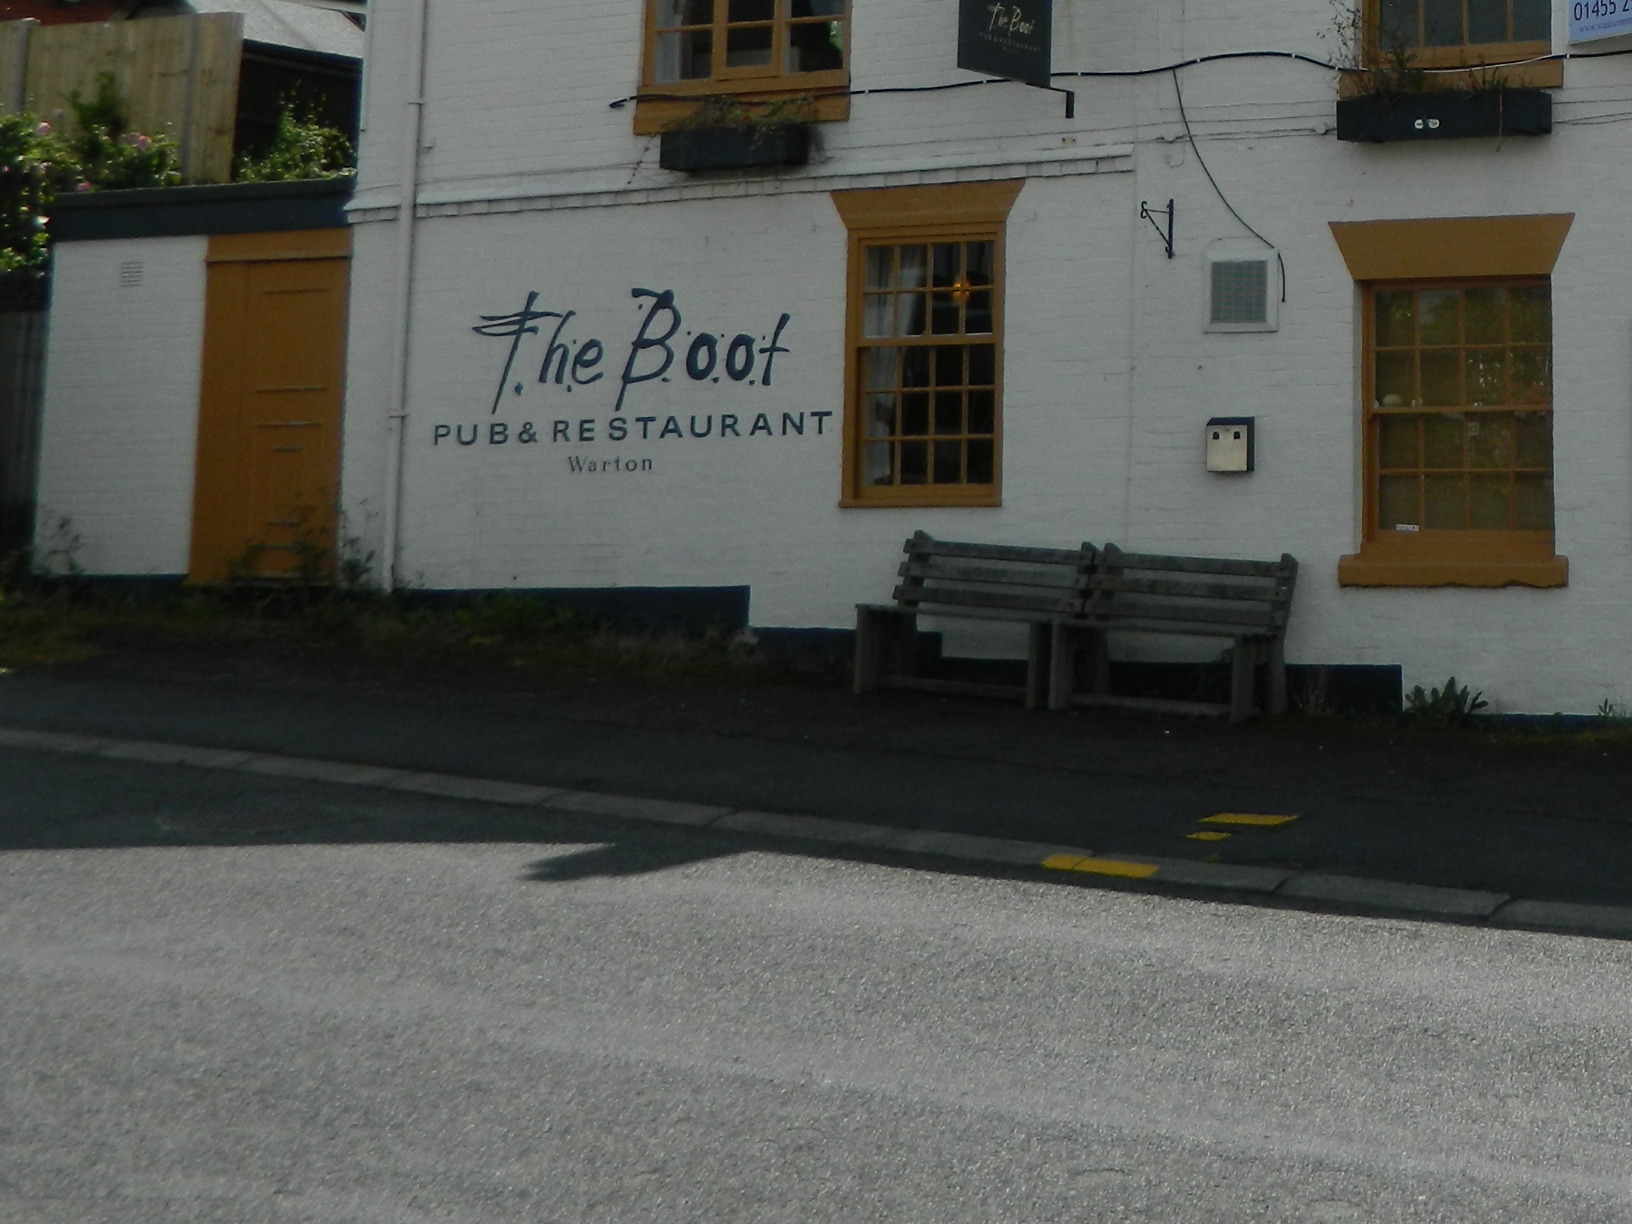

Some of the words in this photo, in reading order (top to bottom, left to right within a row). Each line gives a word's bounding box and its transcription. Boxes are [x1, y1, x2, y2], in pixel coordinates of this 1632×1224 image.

[471, 290, 605, 415] The
[614, 287, 791, 412] Boot
[567, 455, 654, 473] Warton
